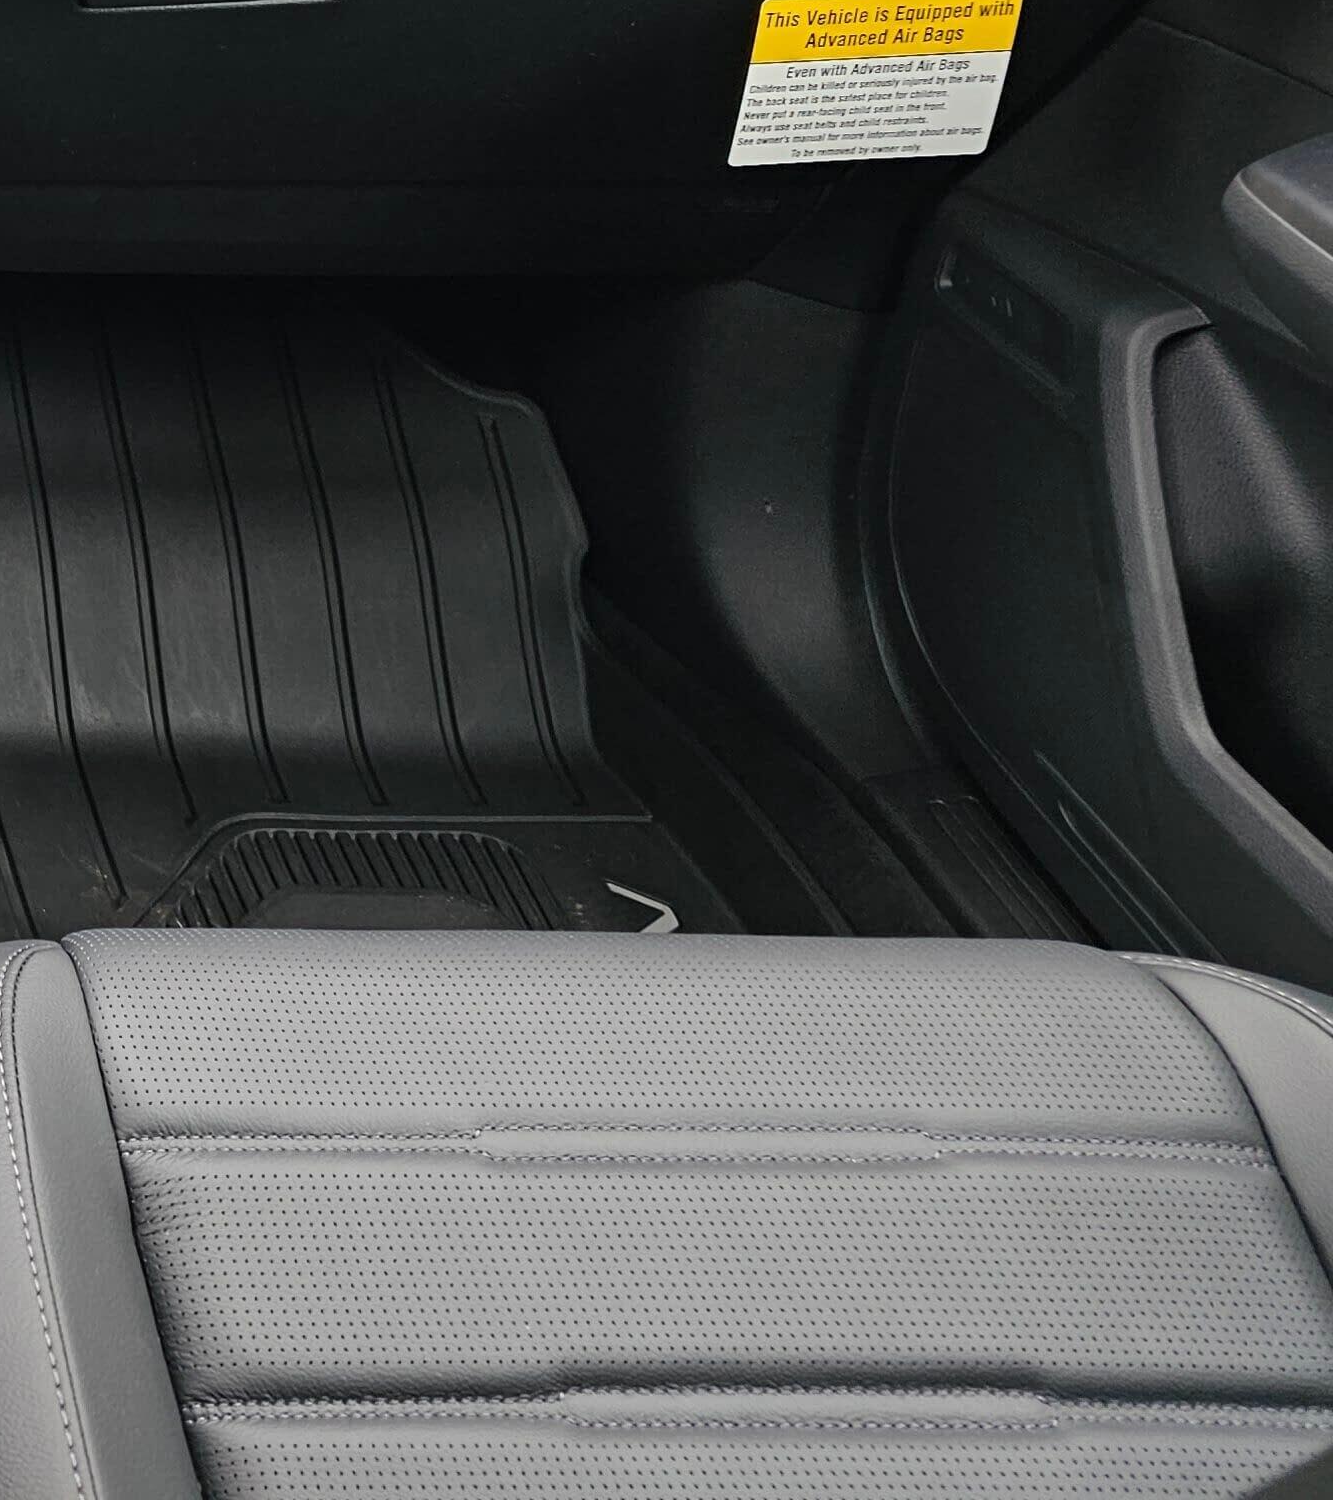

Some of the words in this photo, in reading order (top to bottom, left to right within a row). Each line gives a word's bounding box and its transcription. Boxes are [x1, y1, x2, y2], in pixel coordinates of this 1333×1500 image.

[766, 12, 801, 28] This
[807, 7, 868, 26] Vehicle
[874, 6, 890, 22] is
[895, 2, 974, 24] Equipped
[979, 0, 1015, 16] with
[805, 29, 889, 48] Advanced
[893, 28, 918, 44] Air
[923, 26, 965, 44] Bags
[786, 66, 817, 78] Even
[821, 64, 847, 77] with
[851, 61, 913, 75] Advanced
[916, 60, 935, 72] Air
[938, 59, 971, 72] Bags
[750, 85, 787, 93] Children
[789, 84, 805, 92] can
[807, 83, 818, 91] be
[821, 81, 846, 90] killed
[848, 81, 858, 89] or
[859, 79, 900, 88] seriously
[936, 77, 947, 86] by
[965, 75, 978, 83] air
[747, 98, 763, 107] The
[765, 98, 786, 106] back
[789, 96, 809, 105] seat
[821, 95, 836, 103] the
[838, 94, 866, 103] safest
[868, 92, 892, 102] place
[744, 111, 771, 120] Never
[772, 110, 787, 120] put
[849, 106, 872, 115] child
[873, 105, 894, 113] seat
[906, 104, 921, 112] the
[740, 124, 773, 133] Always
[775, 123, 791, 131] use
[793, 122, 813, 130] seat
[839, 119, 856, 128] and
[858, 118, 881, 126] child
[736, 137, 754, 146] See
[756, 135, 790, 144] owner's
[792, 133, 827, 143] manual
[867, 130, 918, 139] information
